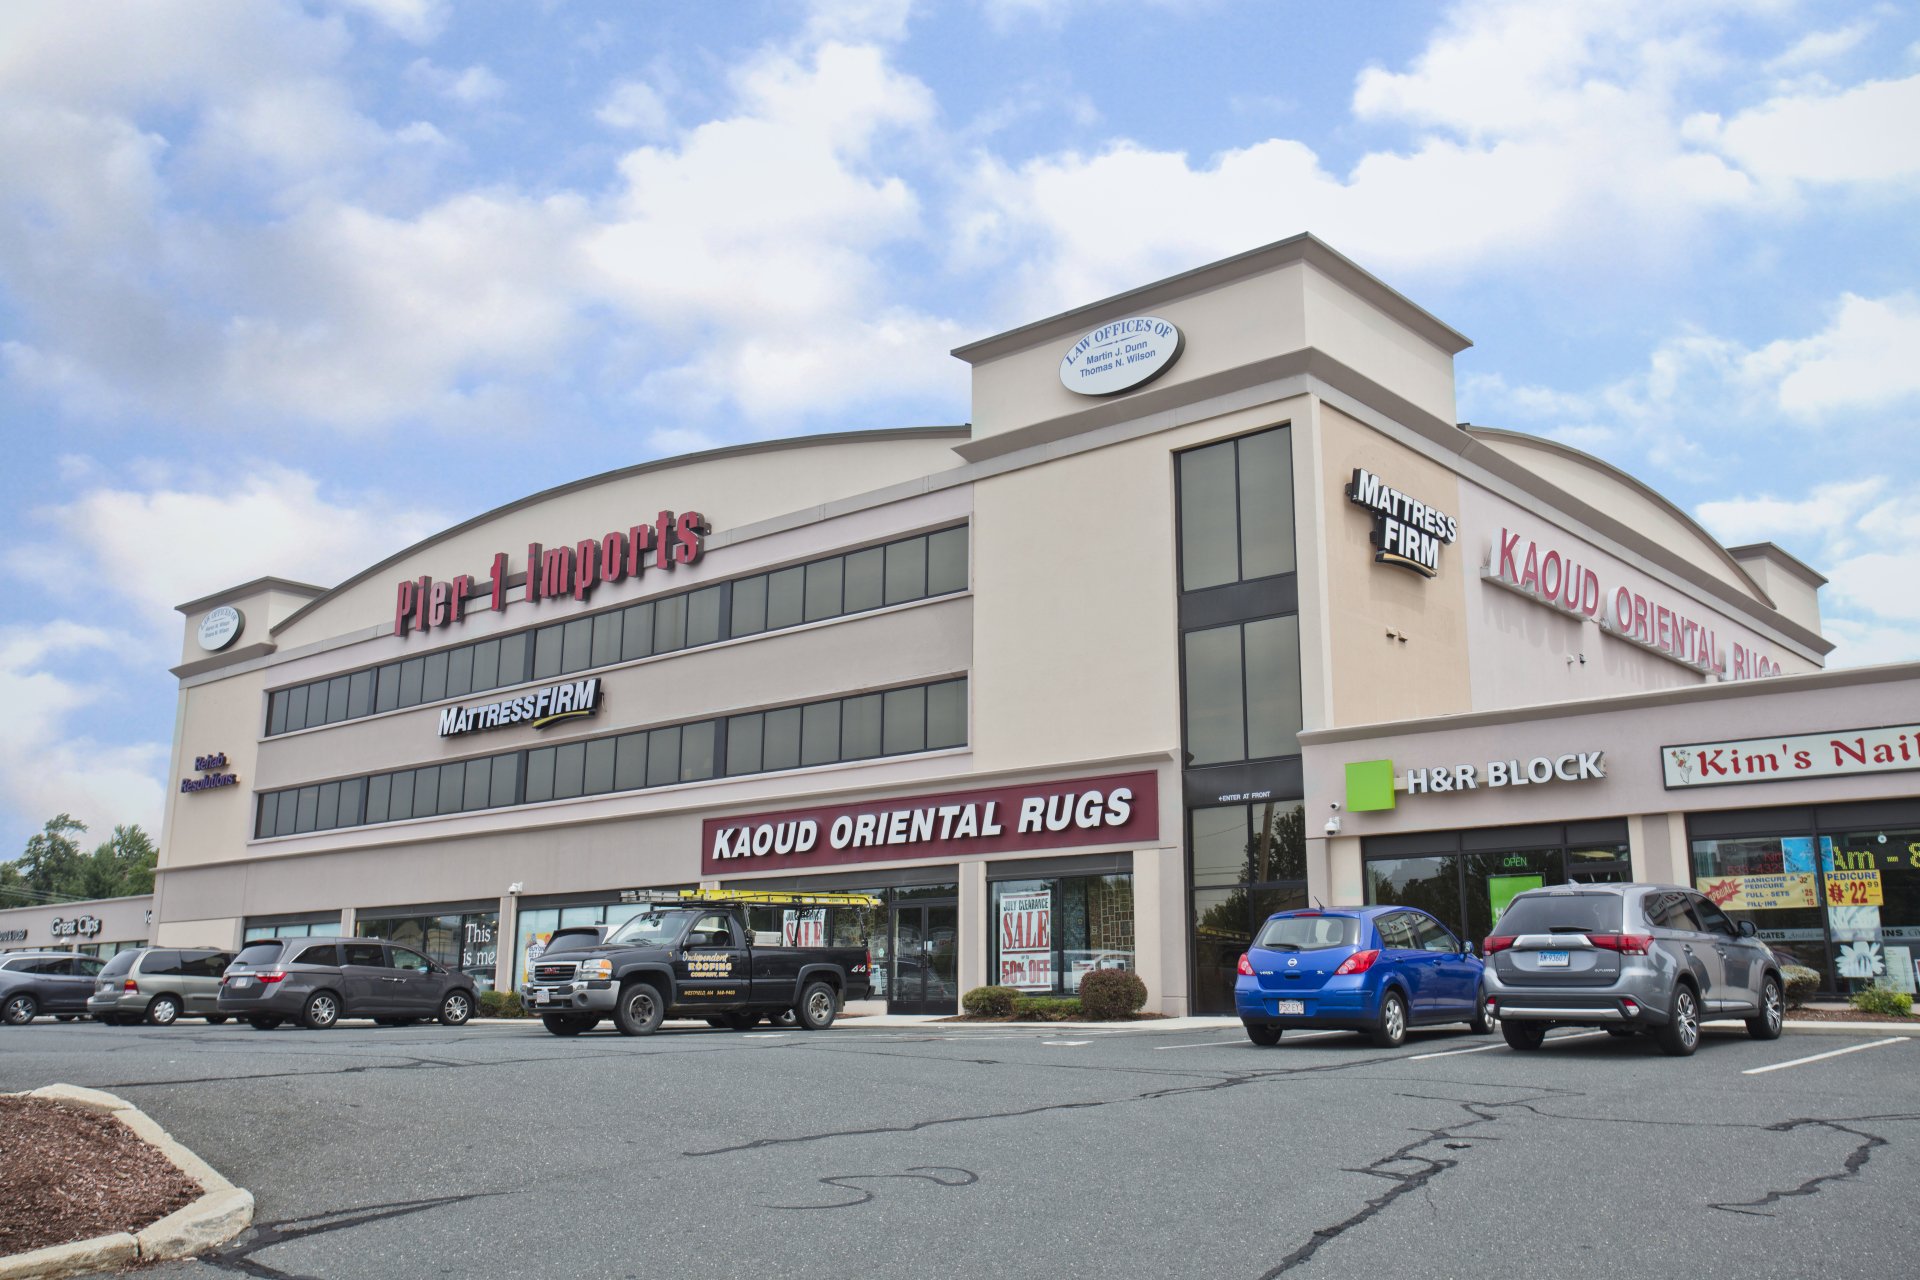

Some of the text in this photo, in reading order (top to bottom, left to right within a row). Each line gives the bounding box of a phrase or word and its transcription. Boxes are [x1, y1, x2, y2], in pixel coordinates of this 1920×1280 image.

[1066, 319, 1173, 366] LAW OFFICES OF
[1086, 341, 1148, 365] Martin J. Dunn
[1080, 349, 1156, 378] Thomas N. Wilson
[1357, 468, 1458, 543] MATTRESS
[1384, 517, 1439, 570] FIRM
[394, 510, 706, 637] Pier 1 Imports
[1499, 527, 1600, 618] KAOUD
[1616, 585, 1723, 674] ORIENTAL
[195, 752, 227, 771] Rehab
[1697, 743, 1813, 777] Kim's
[181, 773, 237, 793] Resolutions
[1406, 750, 1606, 795] H&R BLOCK
[1222, 794, 1241, 802] ENTER
[1251, 791, 1271, 799] FRONT
[712, 787, 1133, 860] KAOUD ORIENTAL RUGS
[1503, 856, 1528, 867] OPEN
[1826, 871, 1878, 881] PEDICURE
[1003, 897, 1049, 912] JULY CLEARANCE
[1747, 900, 1778, 908] FILL-INS
[1771, 890, 1790, 898] SETS
[52, 915, 101, 938] Great Clips
[465, 923, 492, 943] This
[1002, 910, 1050, 949] SALE
[462, 948, 498, 966] is me.
[682, 951, 729, 962] Independent
[688, 962, 732, 971] ROOFING
[1001, 959, 1050, 984] 50% OFF
